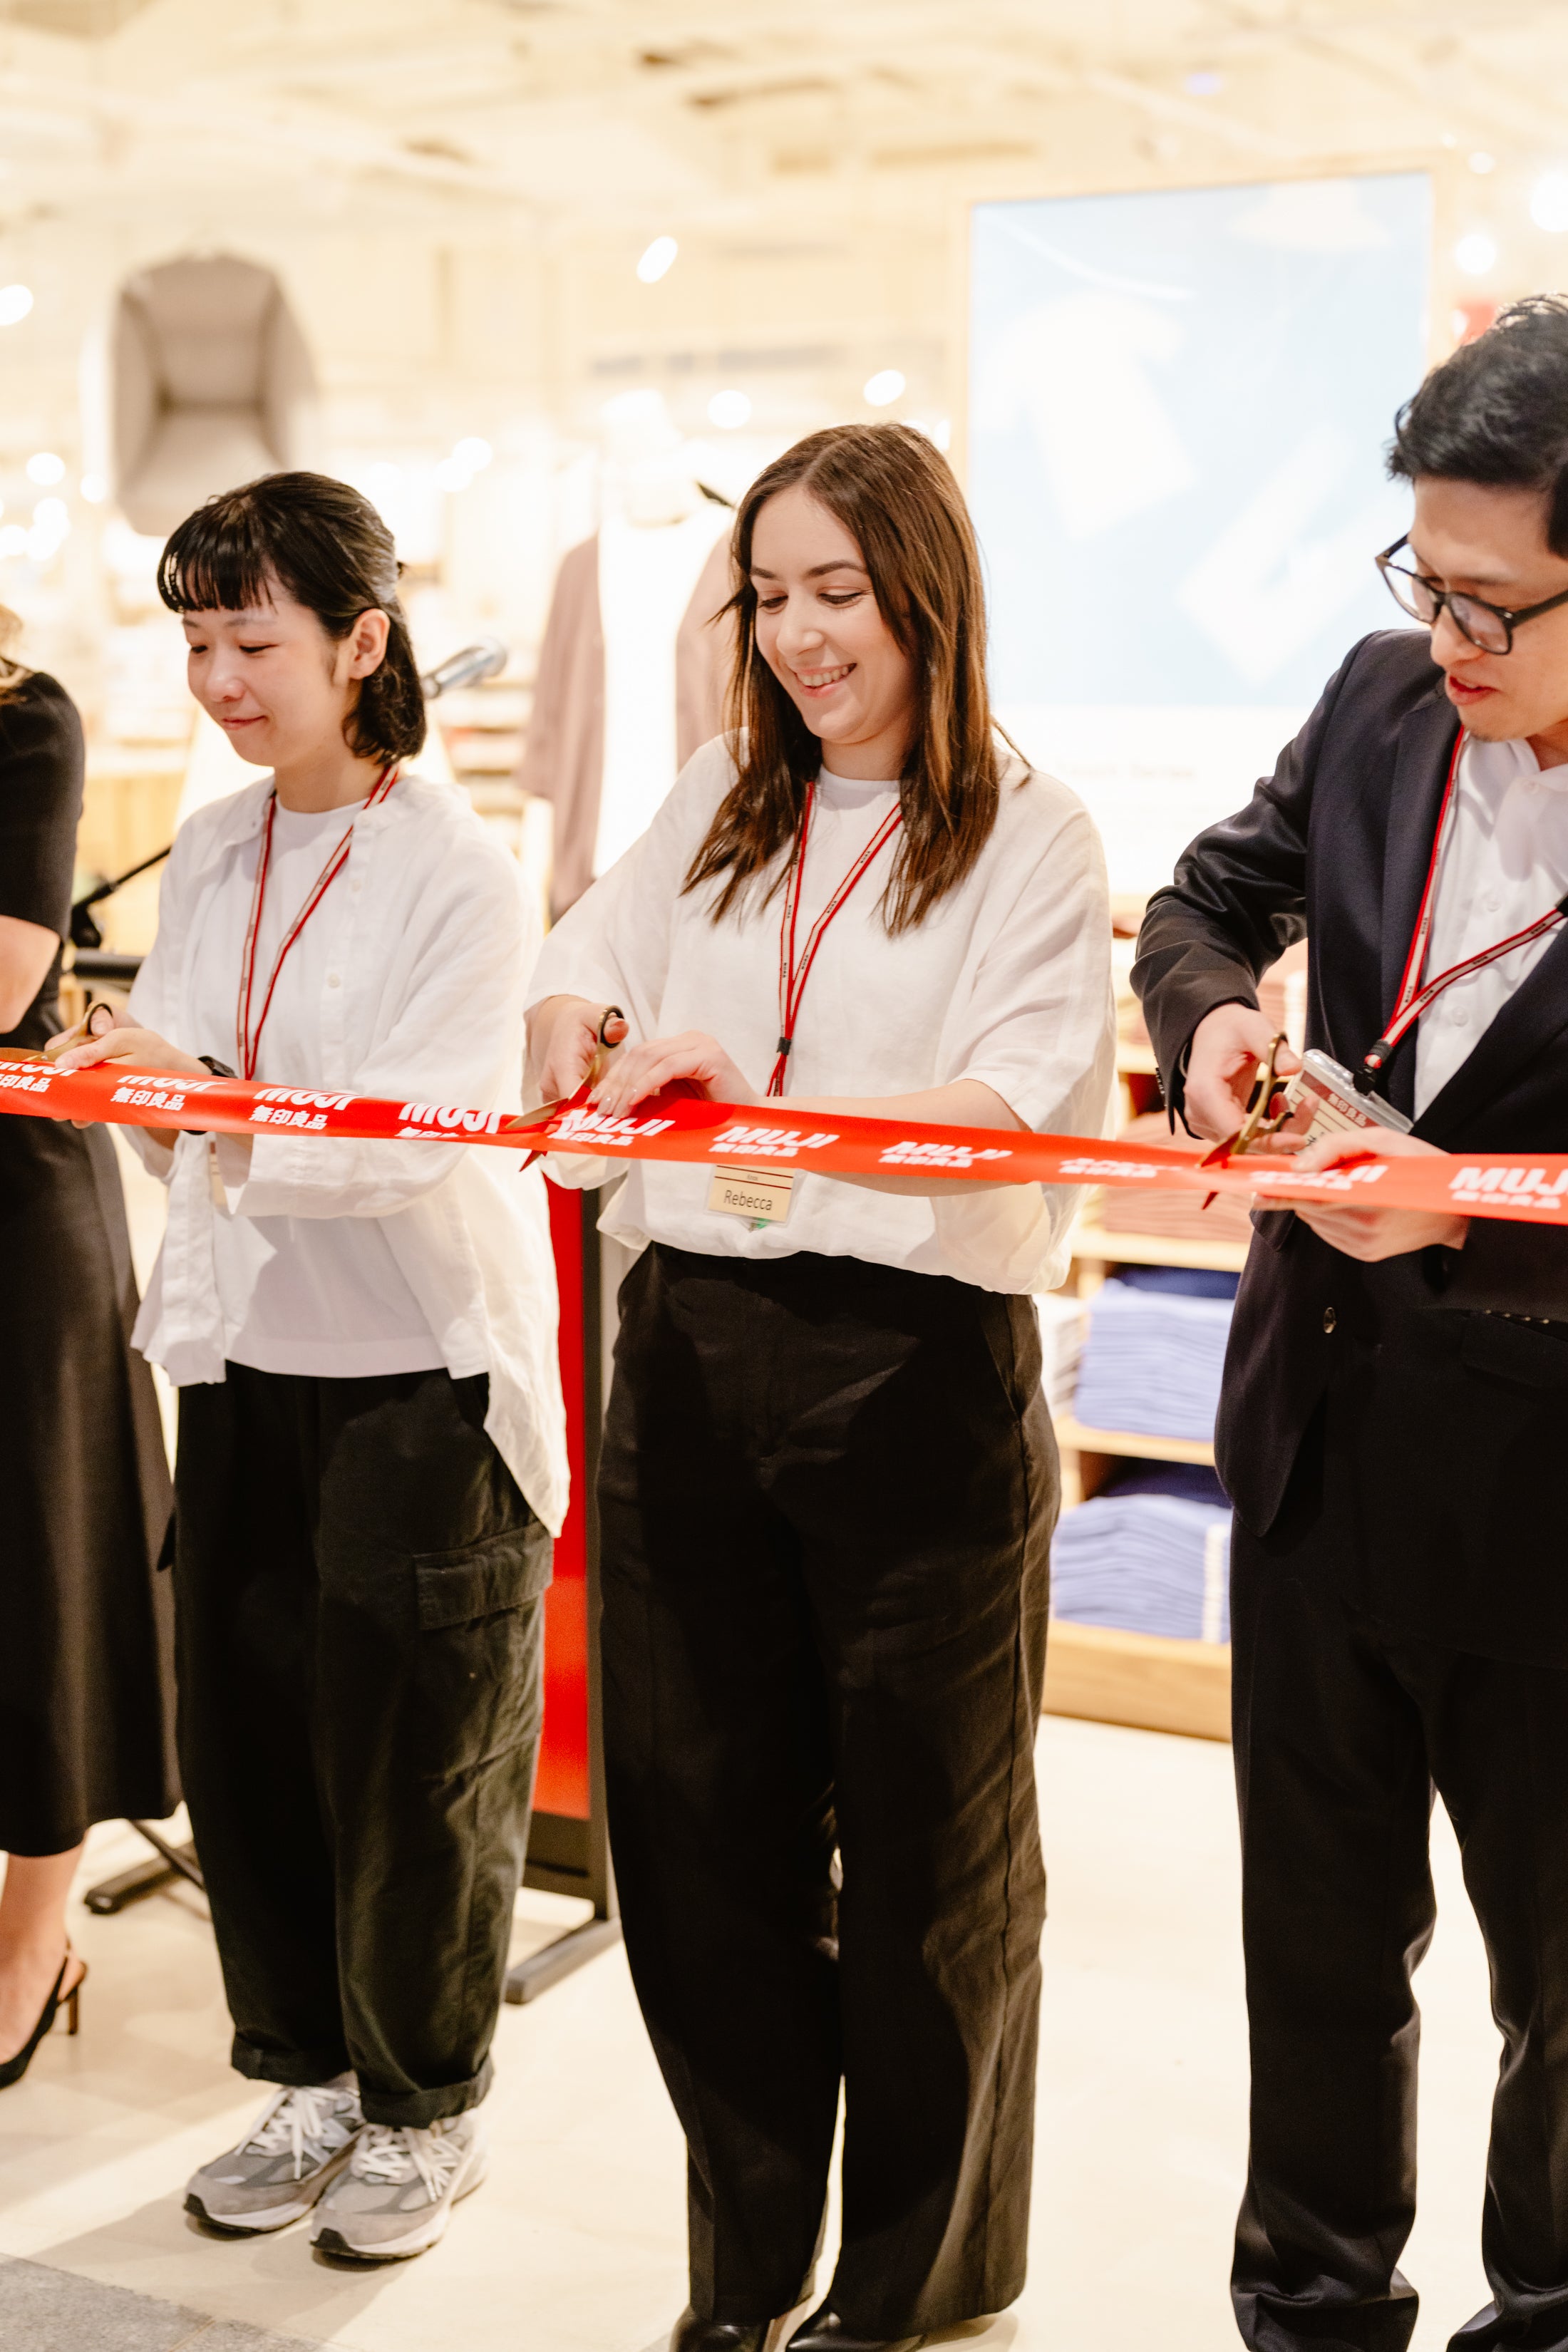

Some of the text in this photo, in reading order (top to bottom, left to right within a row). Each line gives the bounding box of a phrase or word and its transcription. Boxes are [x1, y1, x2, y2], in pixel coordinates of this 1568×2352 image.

[110, 1086, 186, 1111] 無印良品
[249, 1105, 328, 1130] 無印良品
[398, 1103, 500, 1134] MUJI
[557, 1110, 676, 1136] MUJI
[713, 1126, 840, 1148] MUJI
[724, 1190, 773, 1210] Rebecca
